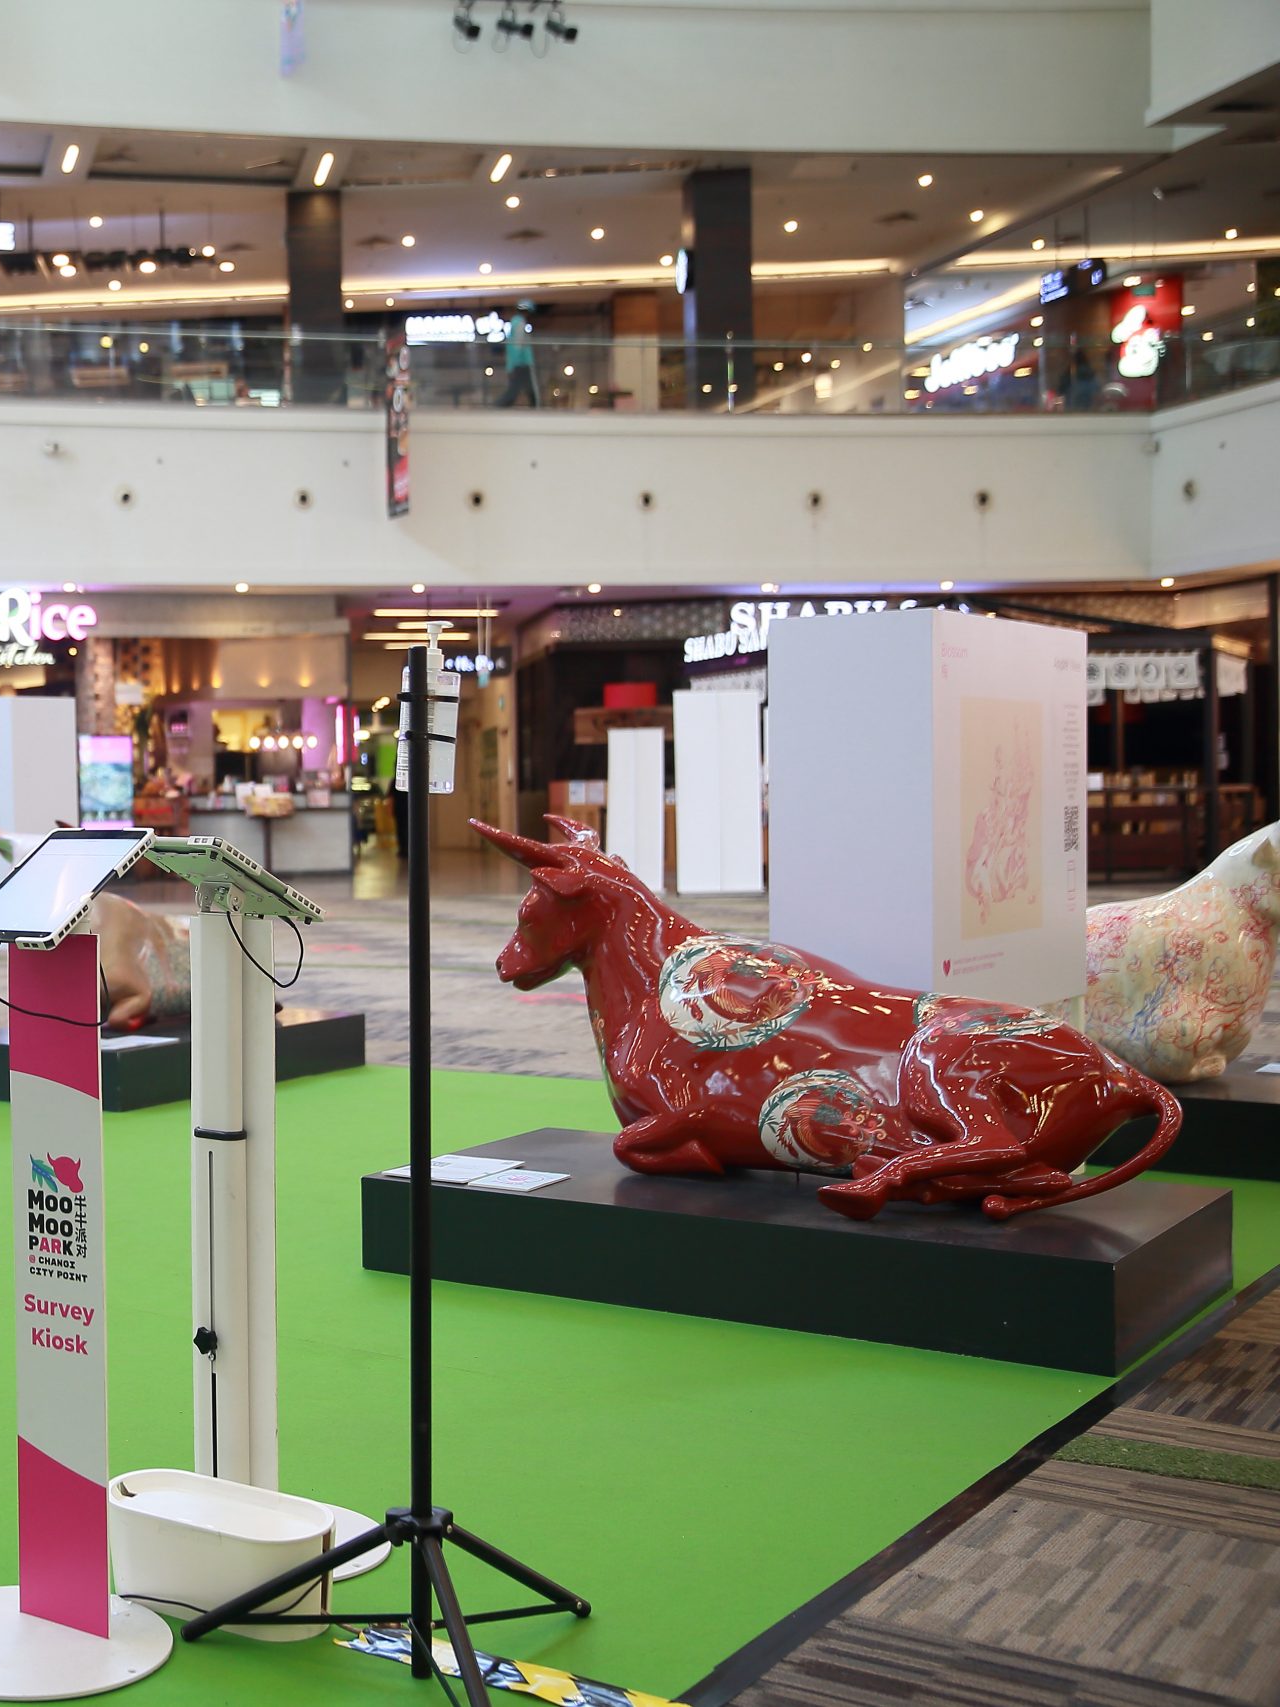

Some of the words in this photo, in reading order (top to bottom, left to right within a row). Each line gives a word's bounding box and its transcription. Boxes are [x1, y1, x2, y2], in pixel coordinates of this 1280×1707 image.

[28, 1188, 73, 1213] MOO
[28, 1212, 73, 1237] MOO
[28, 1235, 73, 1256] PARK
[29, 1266, 54, 1277] CITY
[56, 1271, 88, 1283] POINT
[24, 1293, 95, 1327] Survey
[31, 1327, 88, 1355] Kiosk
